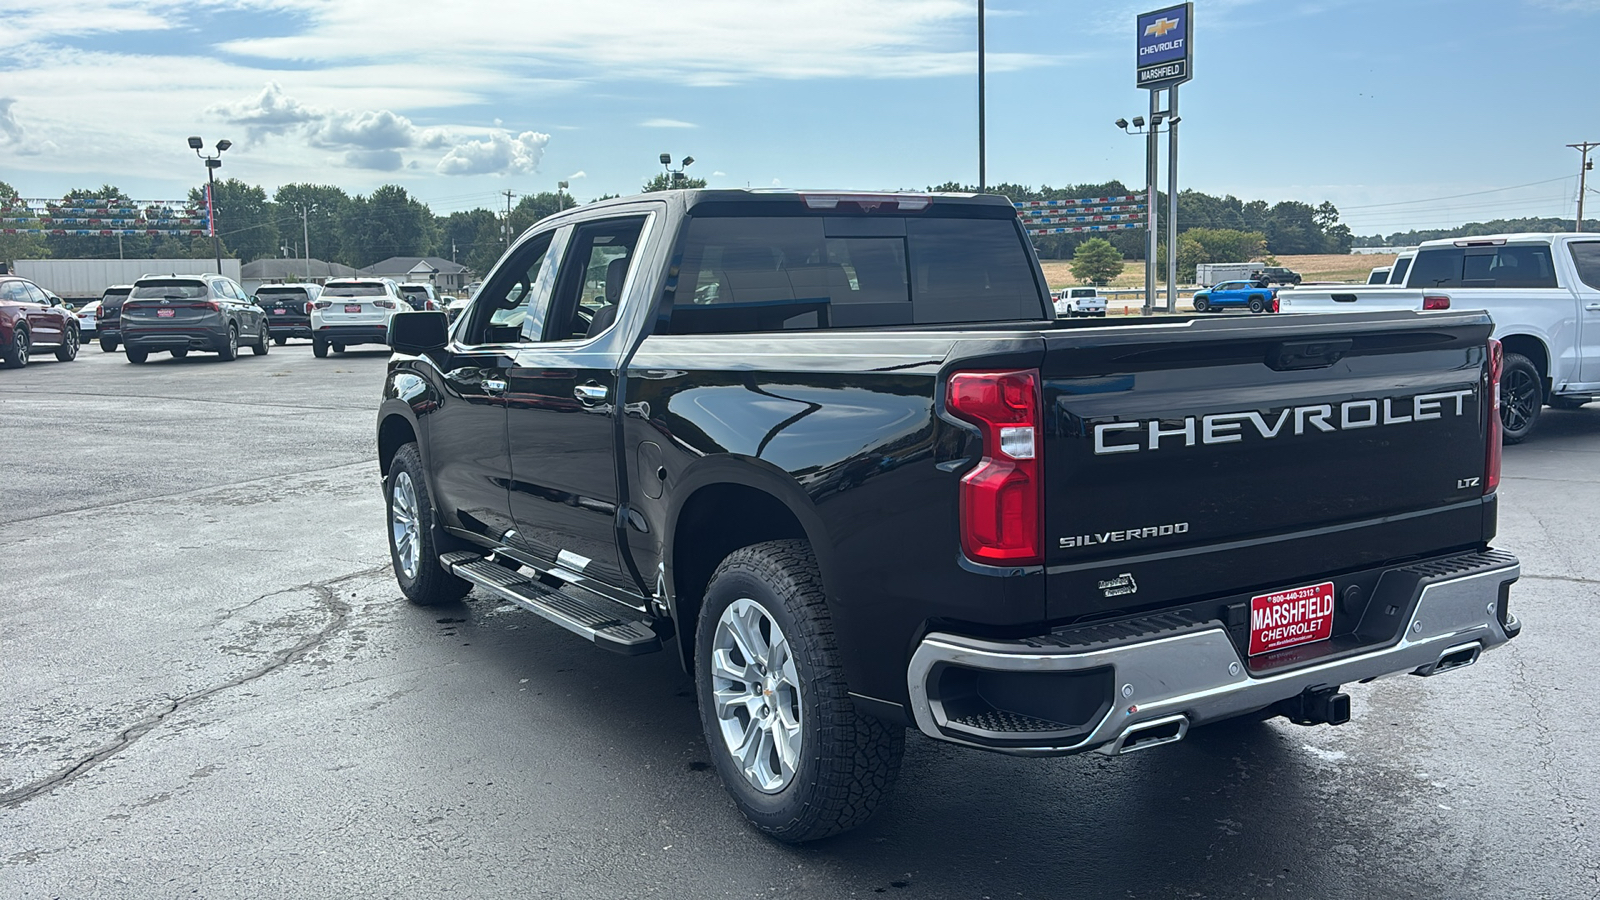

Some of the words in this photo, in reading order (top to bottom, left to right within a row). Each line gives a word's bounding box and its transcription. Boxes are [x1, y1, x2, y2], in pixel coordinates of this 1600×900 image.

[1140, 39, 1183, 56] CHEVROLET
[1141, 64, 1180, 81] MARSHFIELD
[1094, 389, 1473, 454] CHEVROLET
[1457, 476, 1480, 489] LTZ
[1059, 522, 1189, 549] SILVERADO
[1098, 577, 1129, 589] Marshfield
[1104, 586, 1131, 597] Chevrolet
[1272, 588, 1314, 604] 800-440-2312
[1252, 594, 1333, 631] MARSHFIELD
[1261, 618, 1324, 643] CHEVROLET
